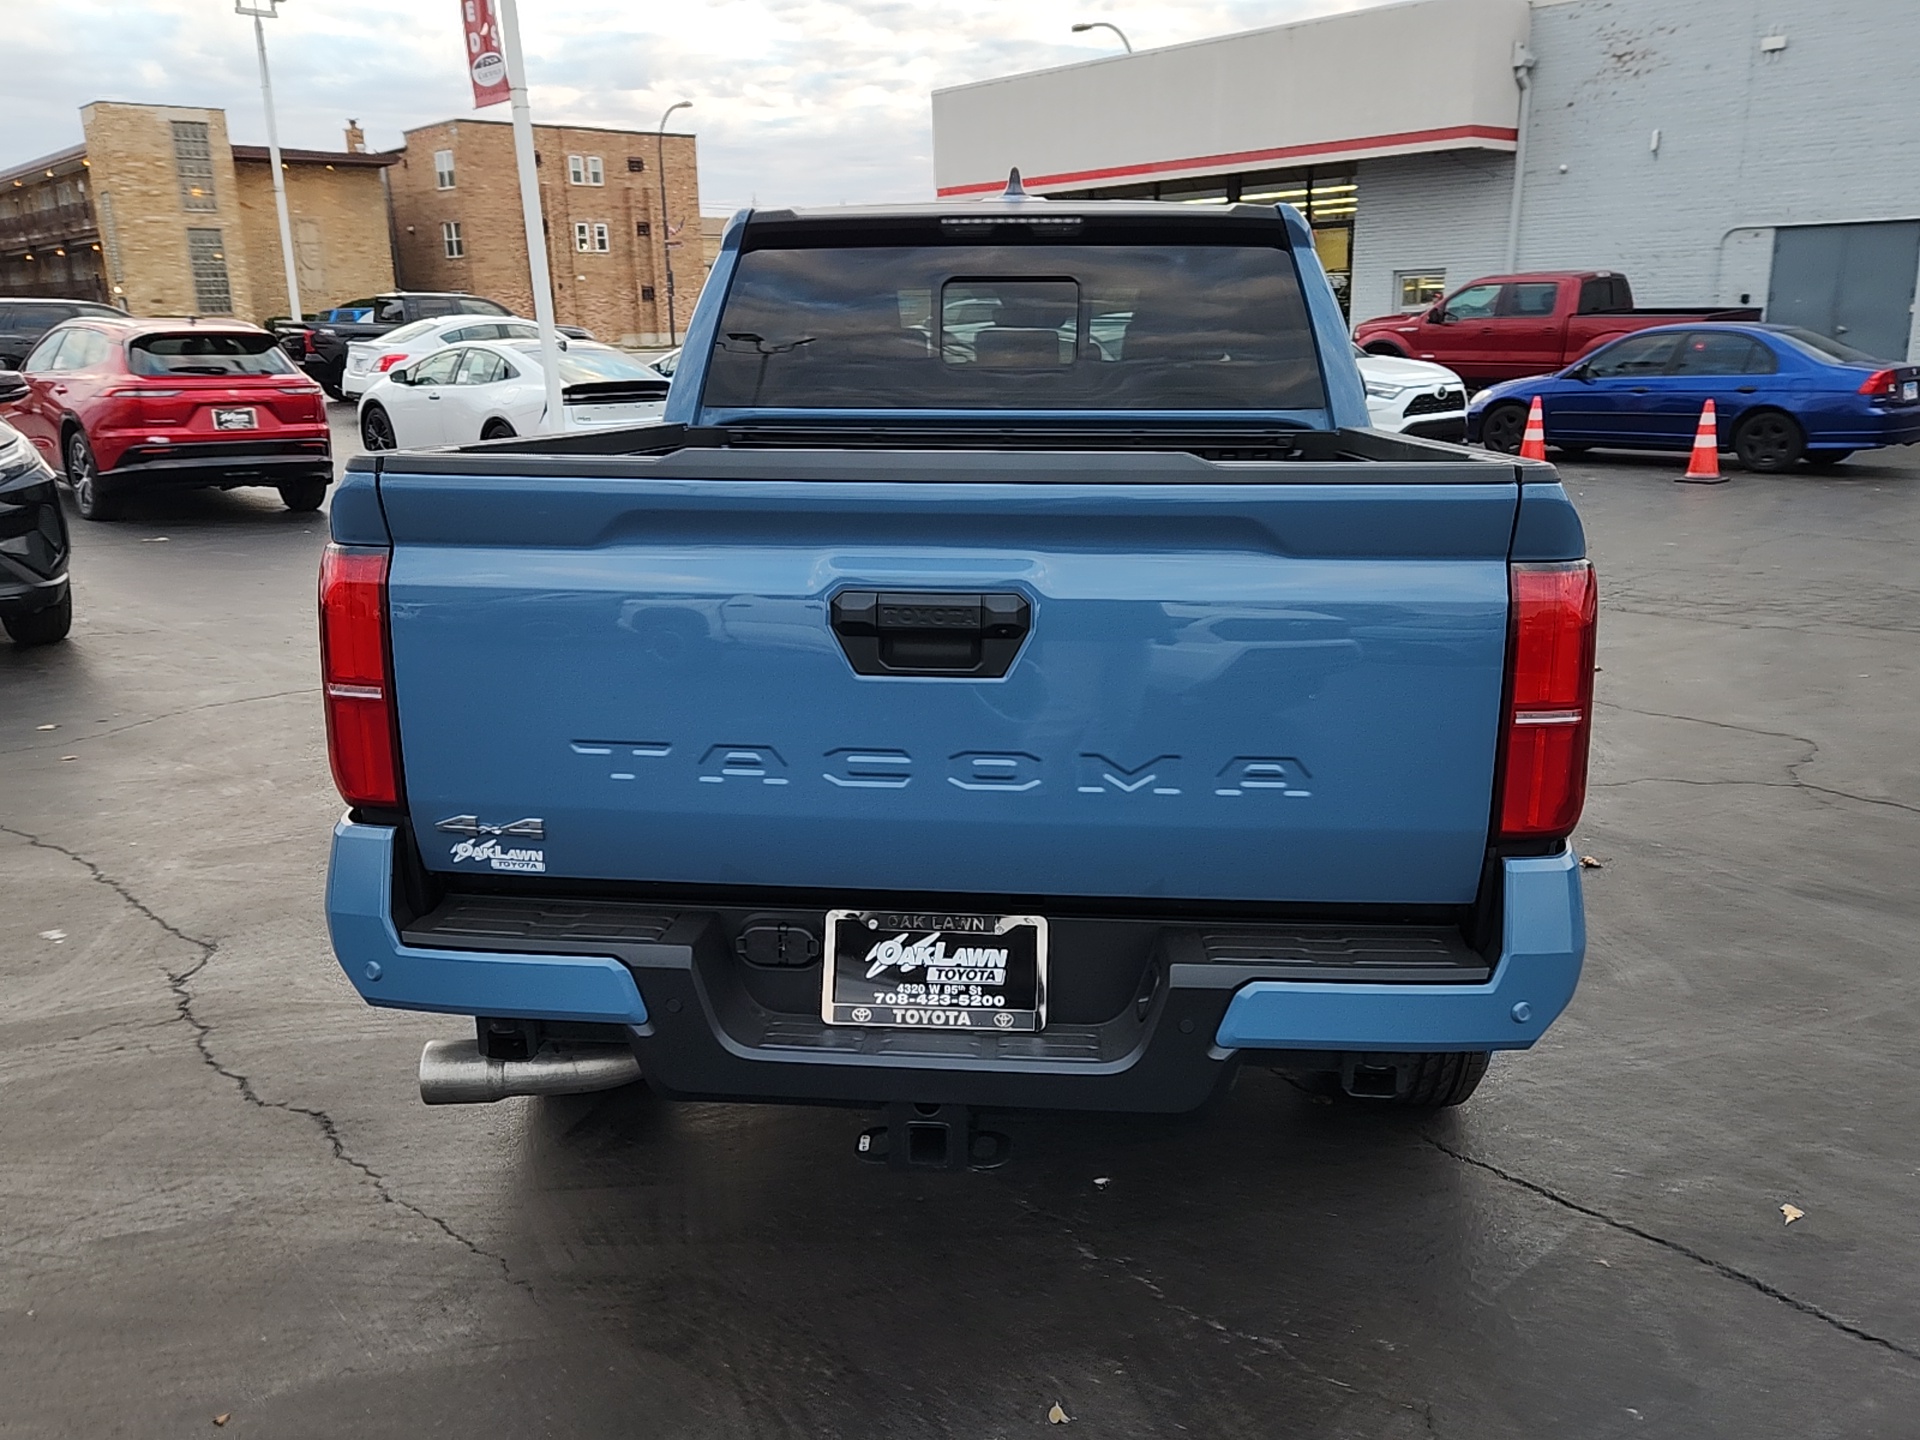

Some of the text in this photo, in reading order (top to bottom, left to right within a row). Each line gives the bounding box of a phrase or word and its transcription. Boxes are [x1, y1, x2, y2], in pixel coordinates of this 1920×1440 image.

[883, 606, 979, 627] TOYOTA
[570, 739, 1312, 797] TACOMA
[498, 861, 538, 870] TOYOTA
[887, 914, 985, 931] OAK LAWN
[935, 968, 996, 981] TOYOTA
[896, 983, 926, 995] 4320
[928, 984, 941, 995] W
[968, 985, 983, 996] St
[873, 992, 1006, 1007] 708-423-5200
[892, 1008, 972, 1026] TOYOTA
